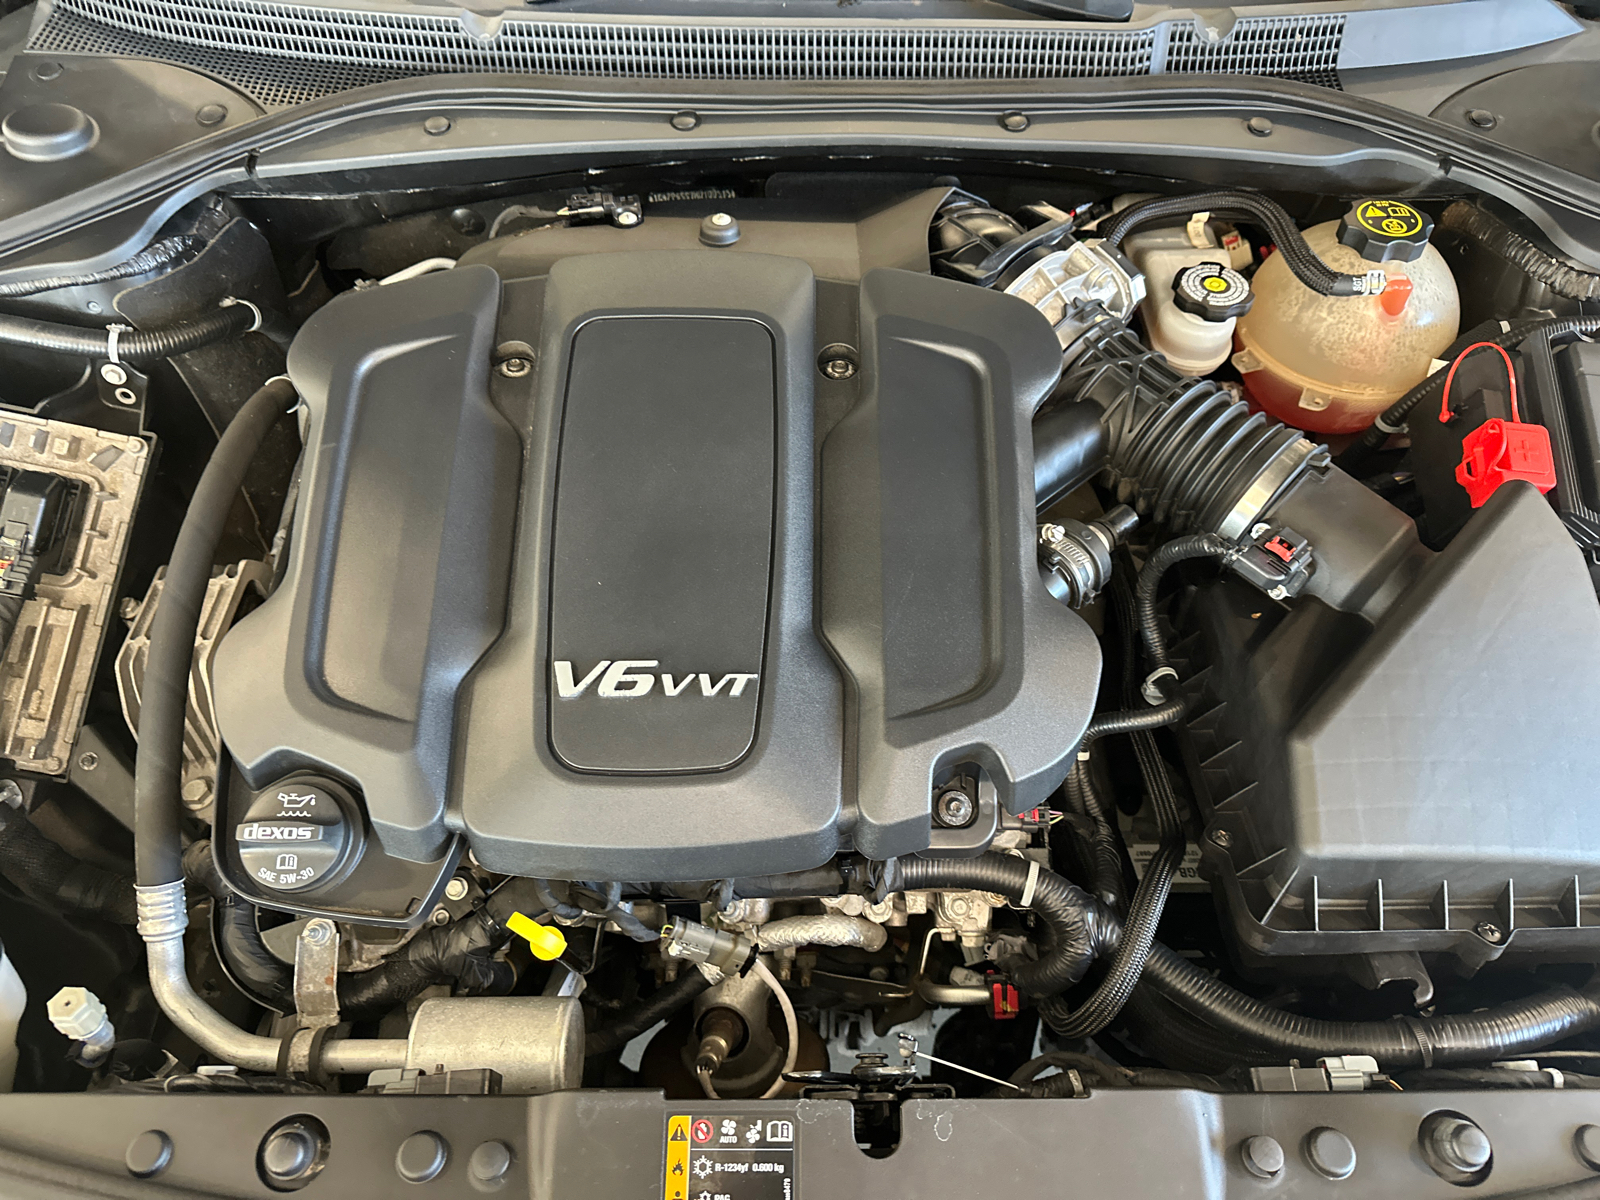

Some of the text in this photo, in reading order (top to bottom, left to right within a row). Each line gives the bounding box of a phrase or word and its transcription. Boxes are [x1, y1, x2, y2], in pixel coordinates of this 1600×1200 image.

[553, 660, 759, 699] V6 VVT
[243, 823, 315, 840] dexos
[257, 866, 315, 884] SAE 5W-30
[719, 1135, 738, 1144] AUTO
[714, 1163, 785, 1174] R-1234yf 0.600 kg
